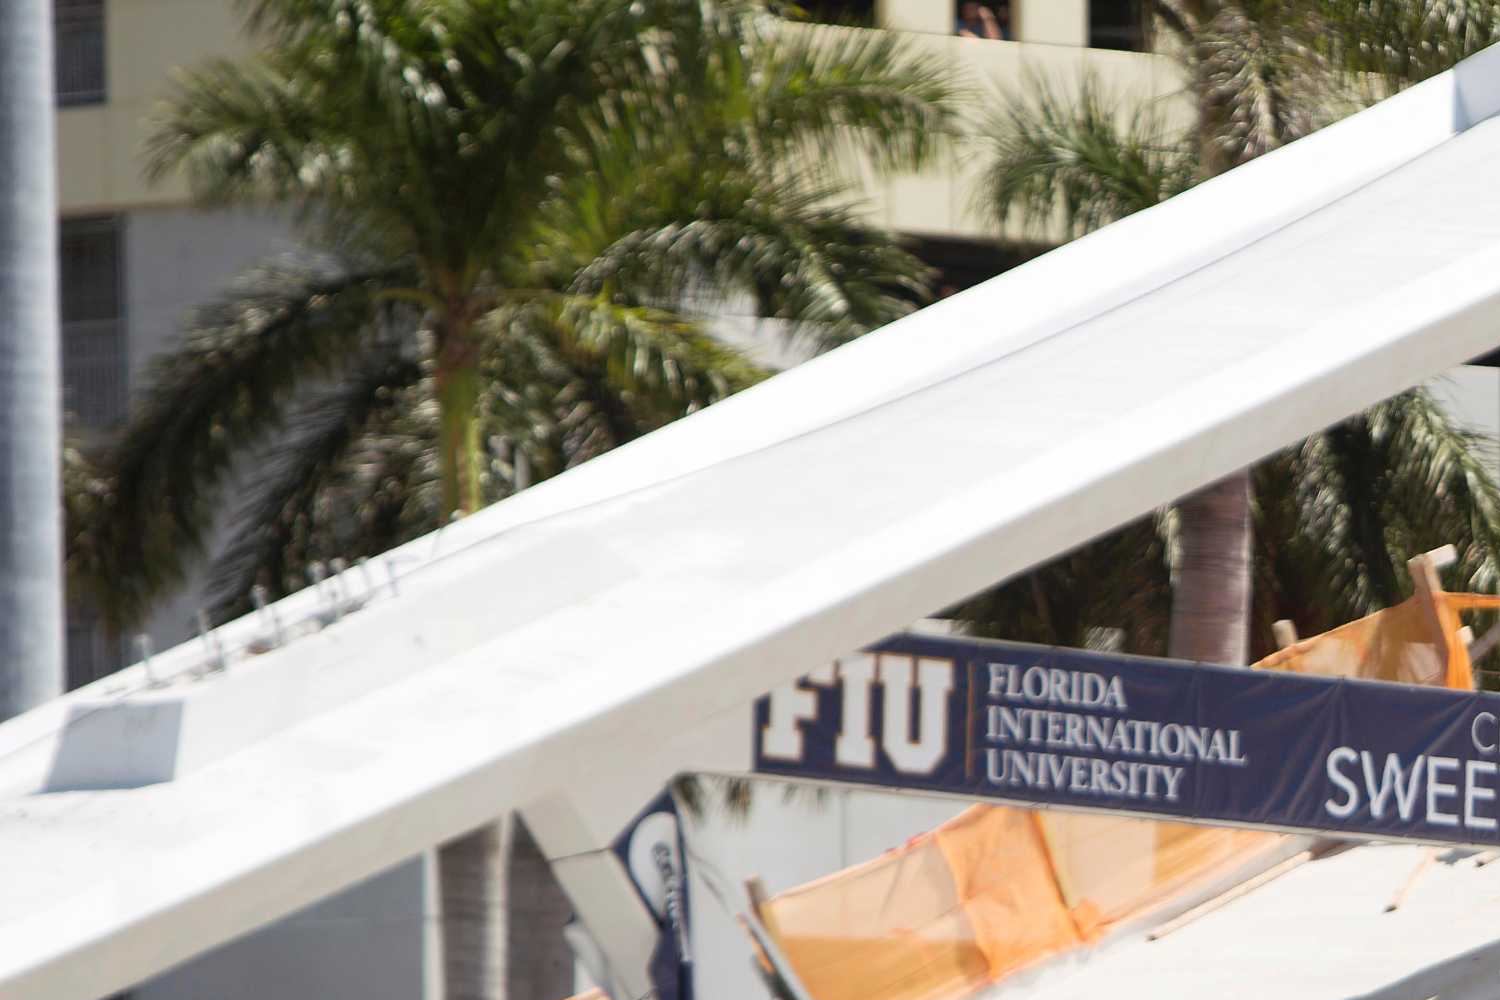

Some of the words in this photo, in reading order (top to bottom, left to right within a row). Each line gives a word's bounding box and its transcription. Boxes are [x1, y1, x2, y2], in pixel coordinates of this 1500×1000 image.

[762, 652, 955, 776] FIU
[987, 662, 1128, 709] FLORIDA
[986, 704, 1248, 767] INTERNATIONAL
[986, 748, 1185, 799] UNIVERSITY
